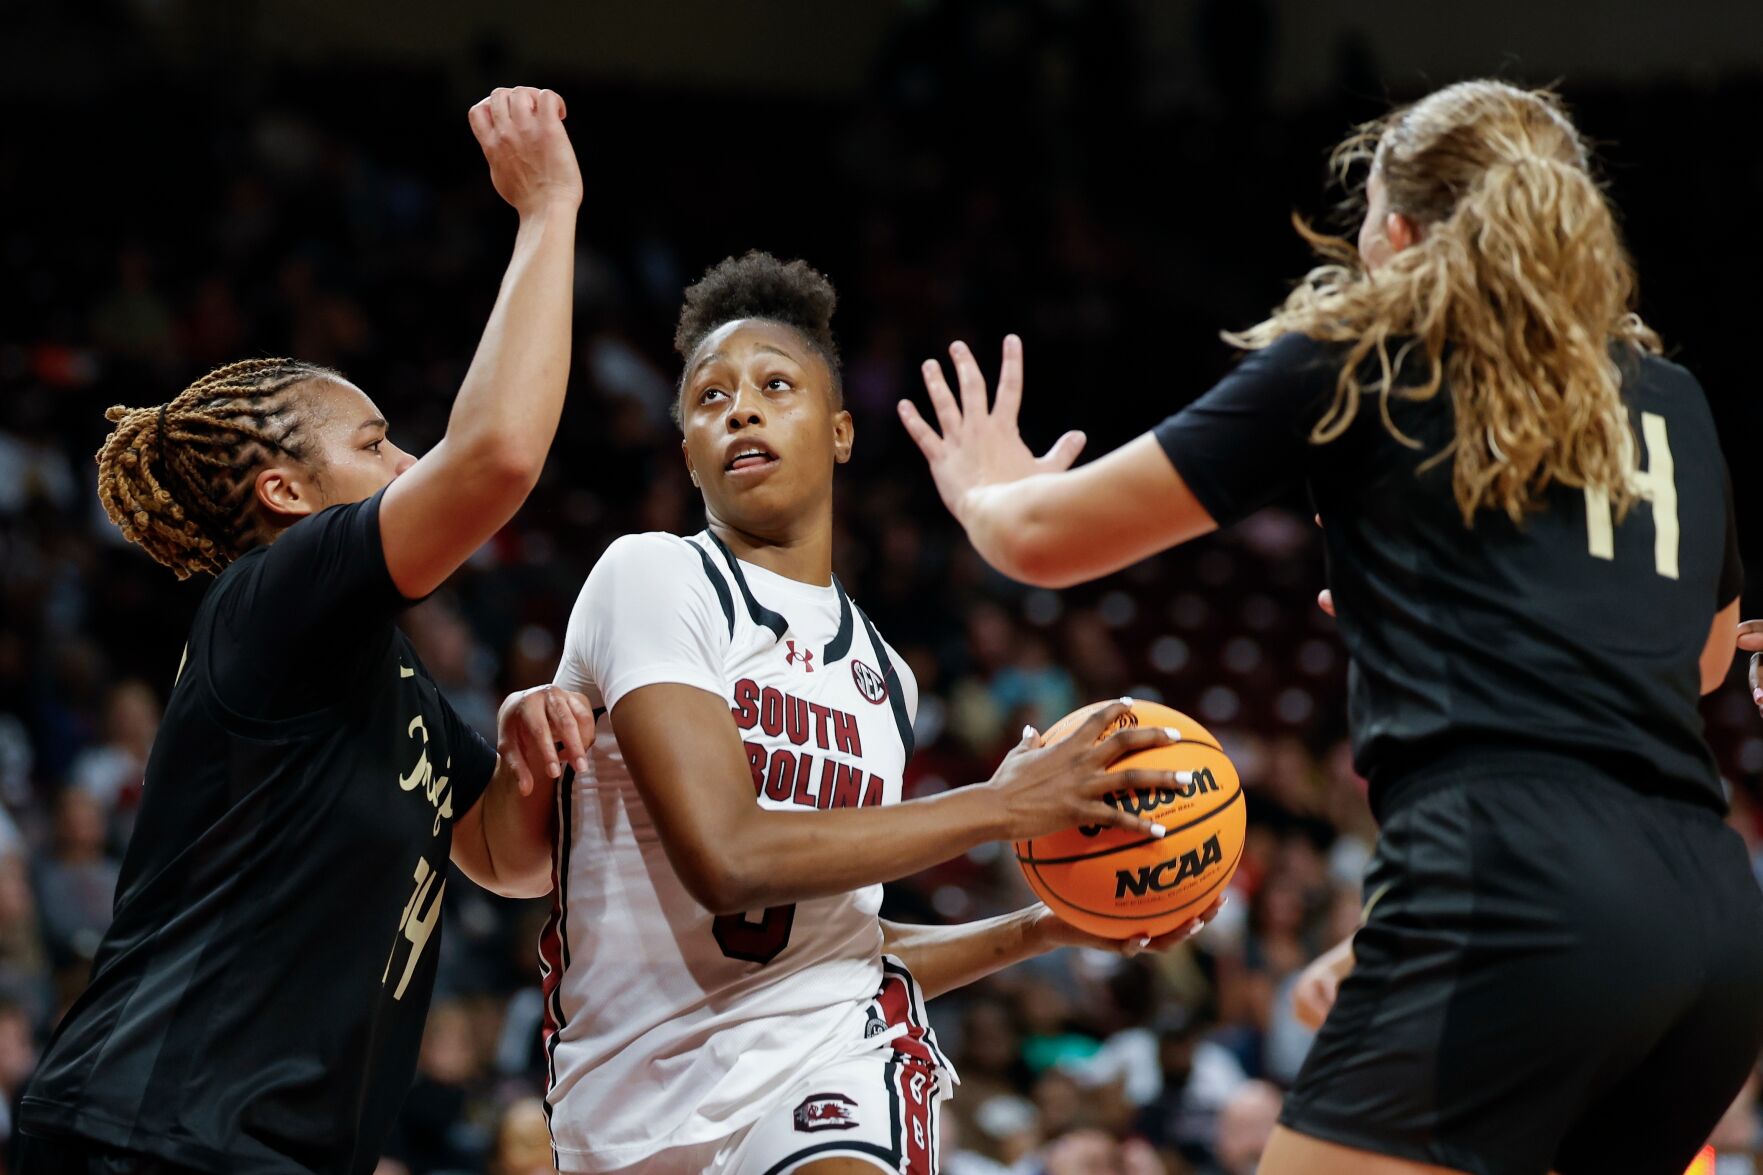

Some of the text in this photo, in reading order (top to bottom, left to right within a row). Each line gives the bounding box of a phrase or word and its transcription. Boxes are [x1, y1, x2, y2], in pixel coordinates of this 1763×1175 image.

[853, 661, 887, 703] SEC
[732, 678, 862, 758] SOUTH
[743, 740, 884, 809] ROLINA
[1114, 834, 1222, 899] NCAA
